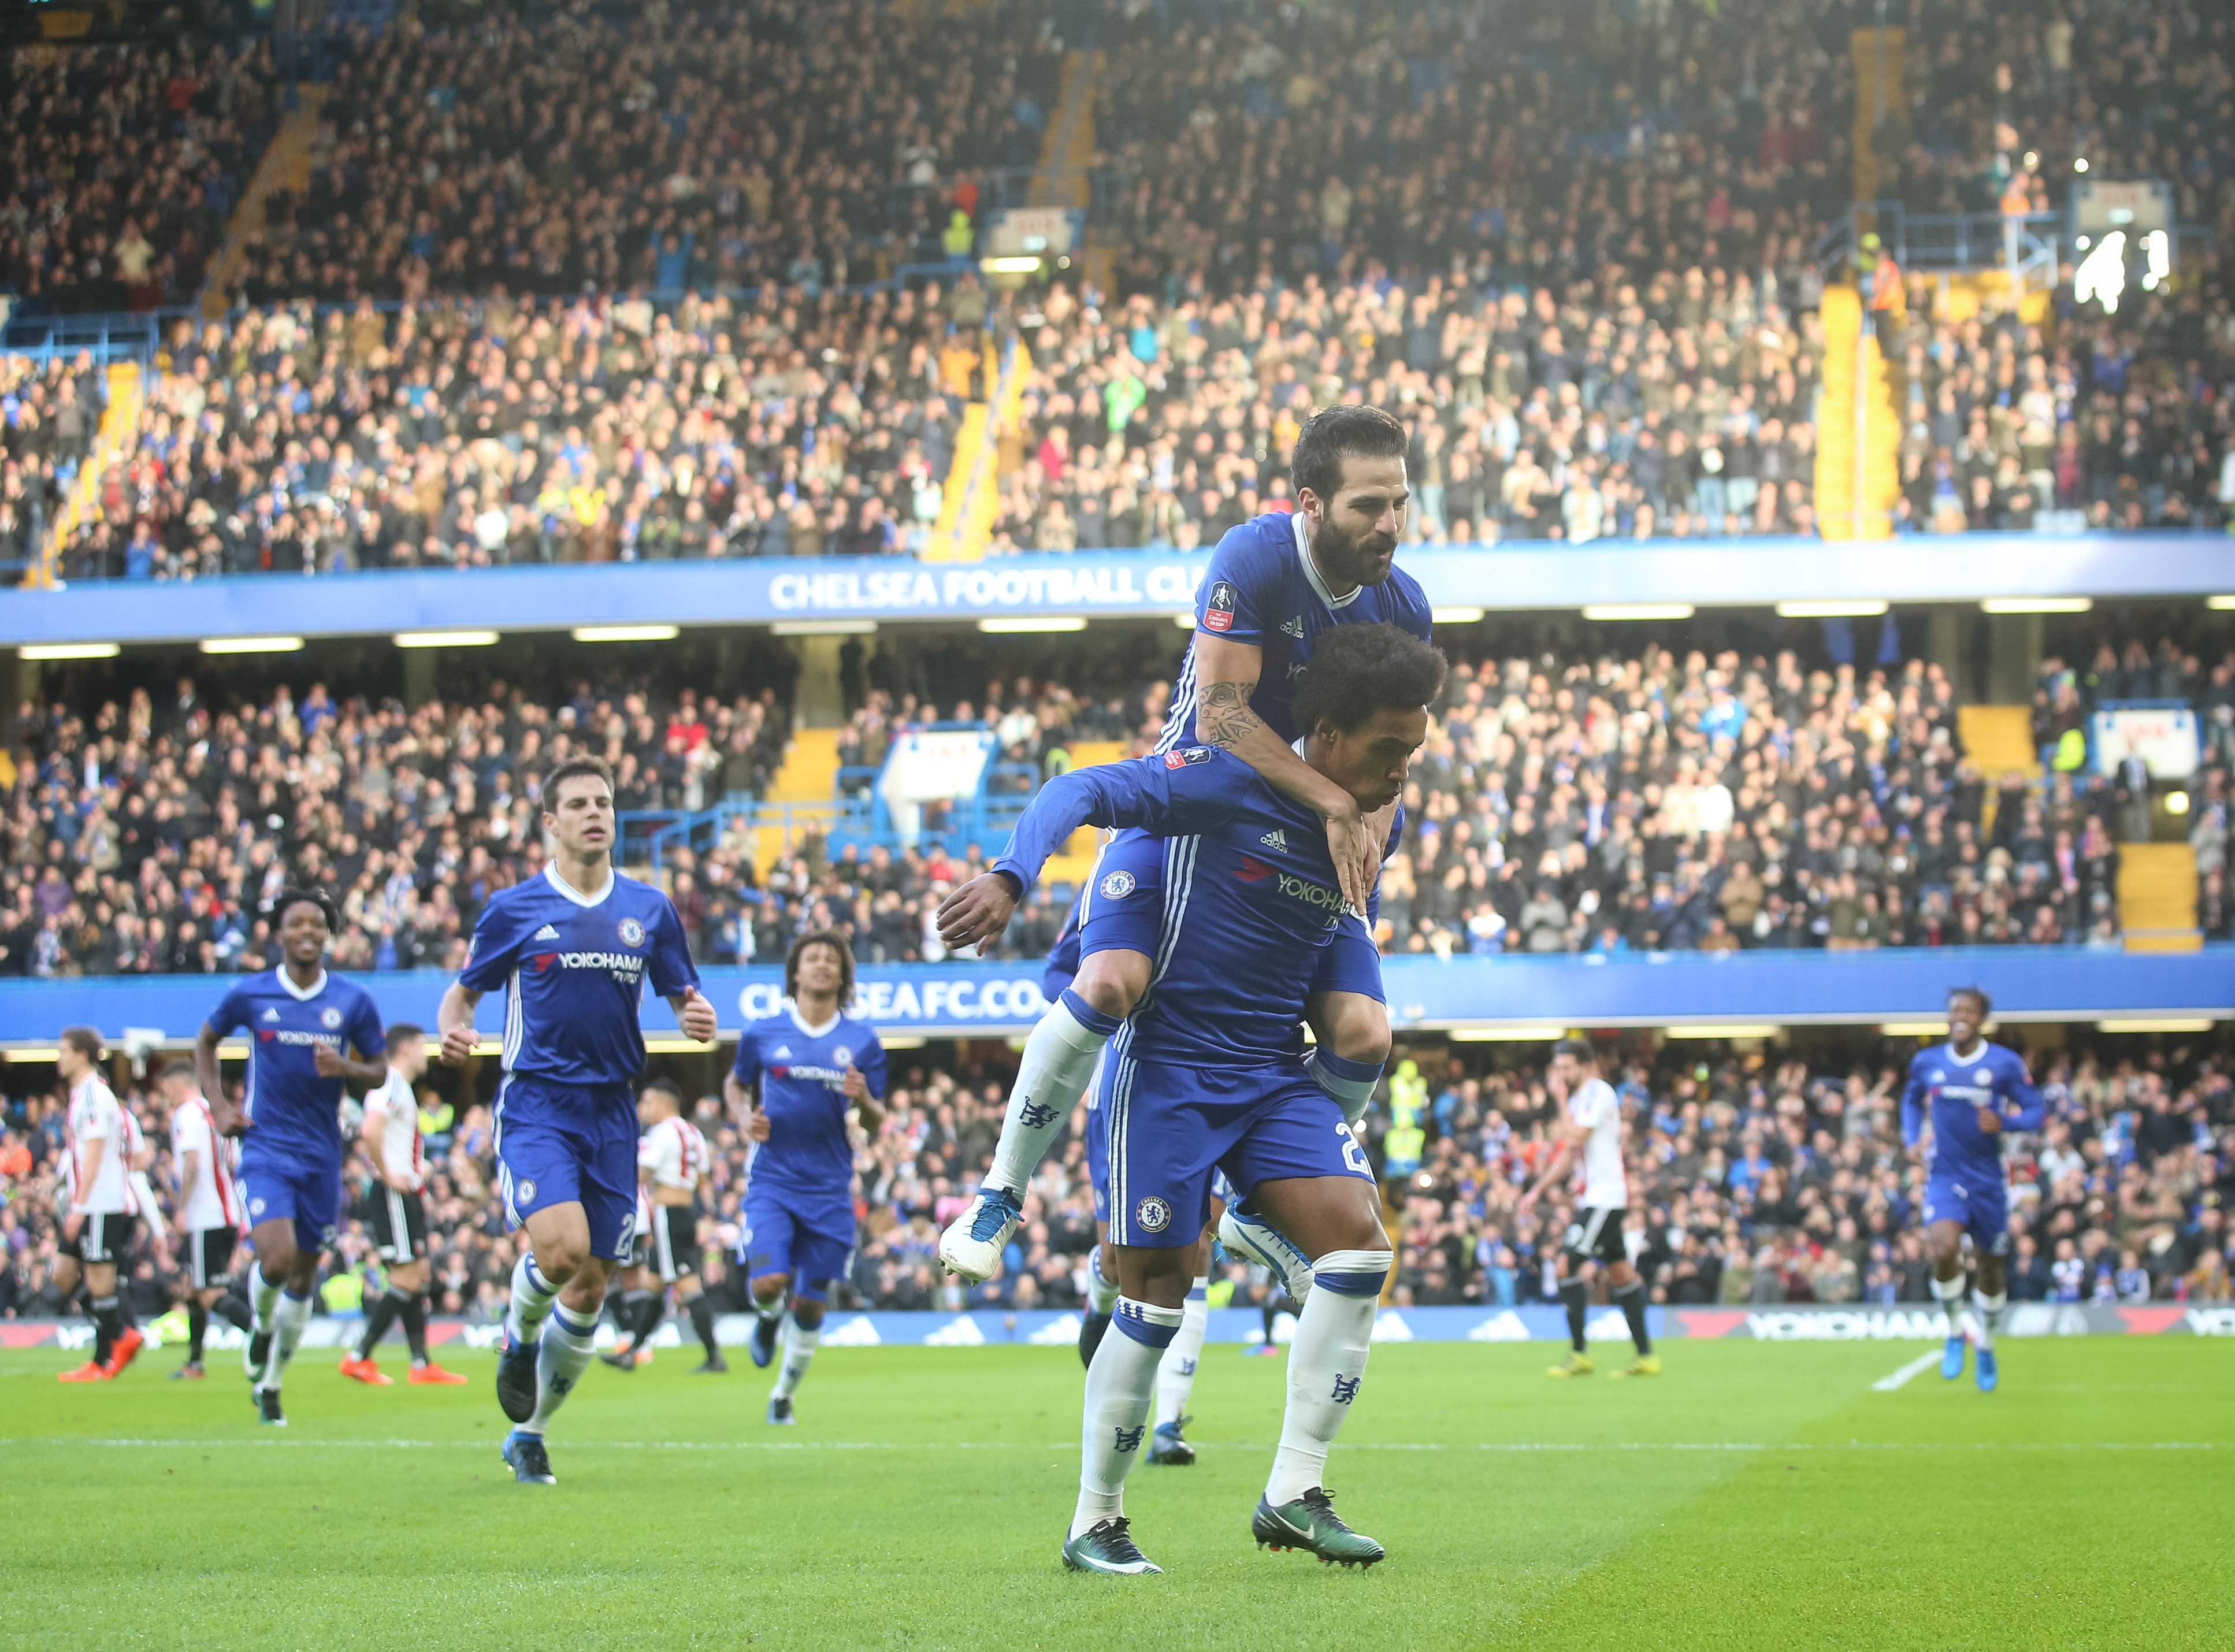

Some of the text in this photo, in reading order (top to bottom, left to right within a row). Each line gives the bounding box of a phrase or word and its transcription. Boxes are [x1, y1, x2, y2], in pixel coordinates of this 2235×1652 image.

[768, 571, 939, 610] CHELSEA
[944, 568, 1142, 607] FOOTBALL
[1261, 837, 1288, 853] adidas
